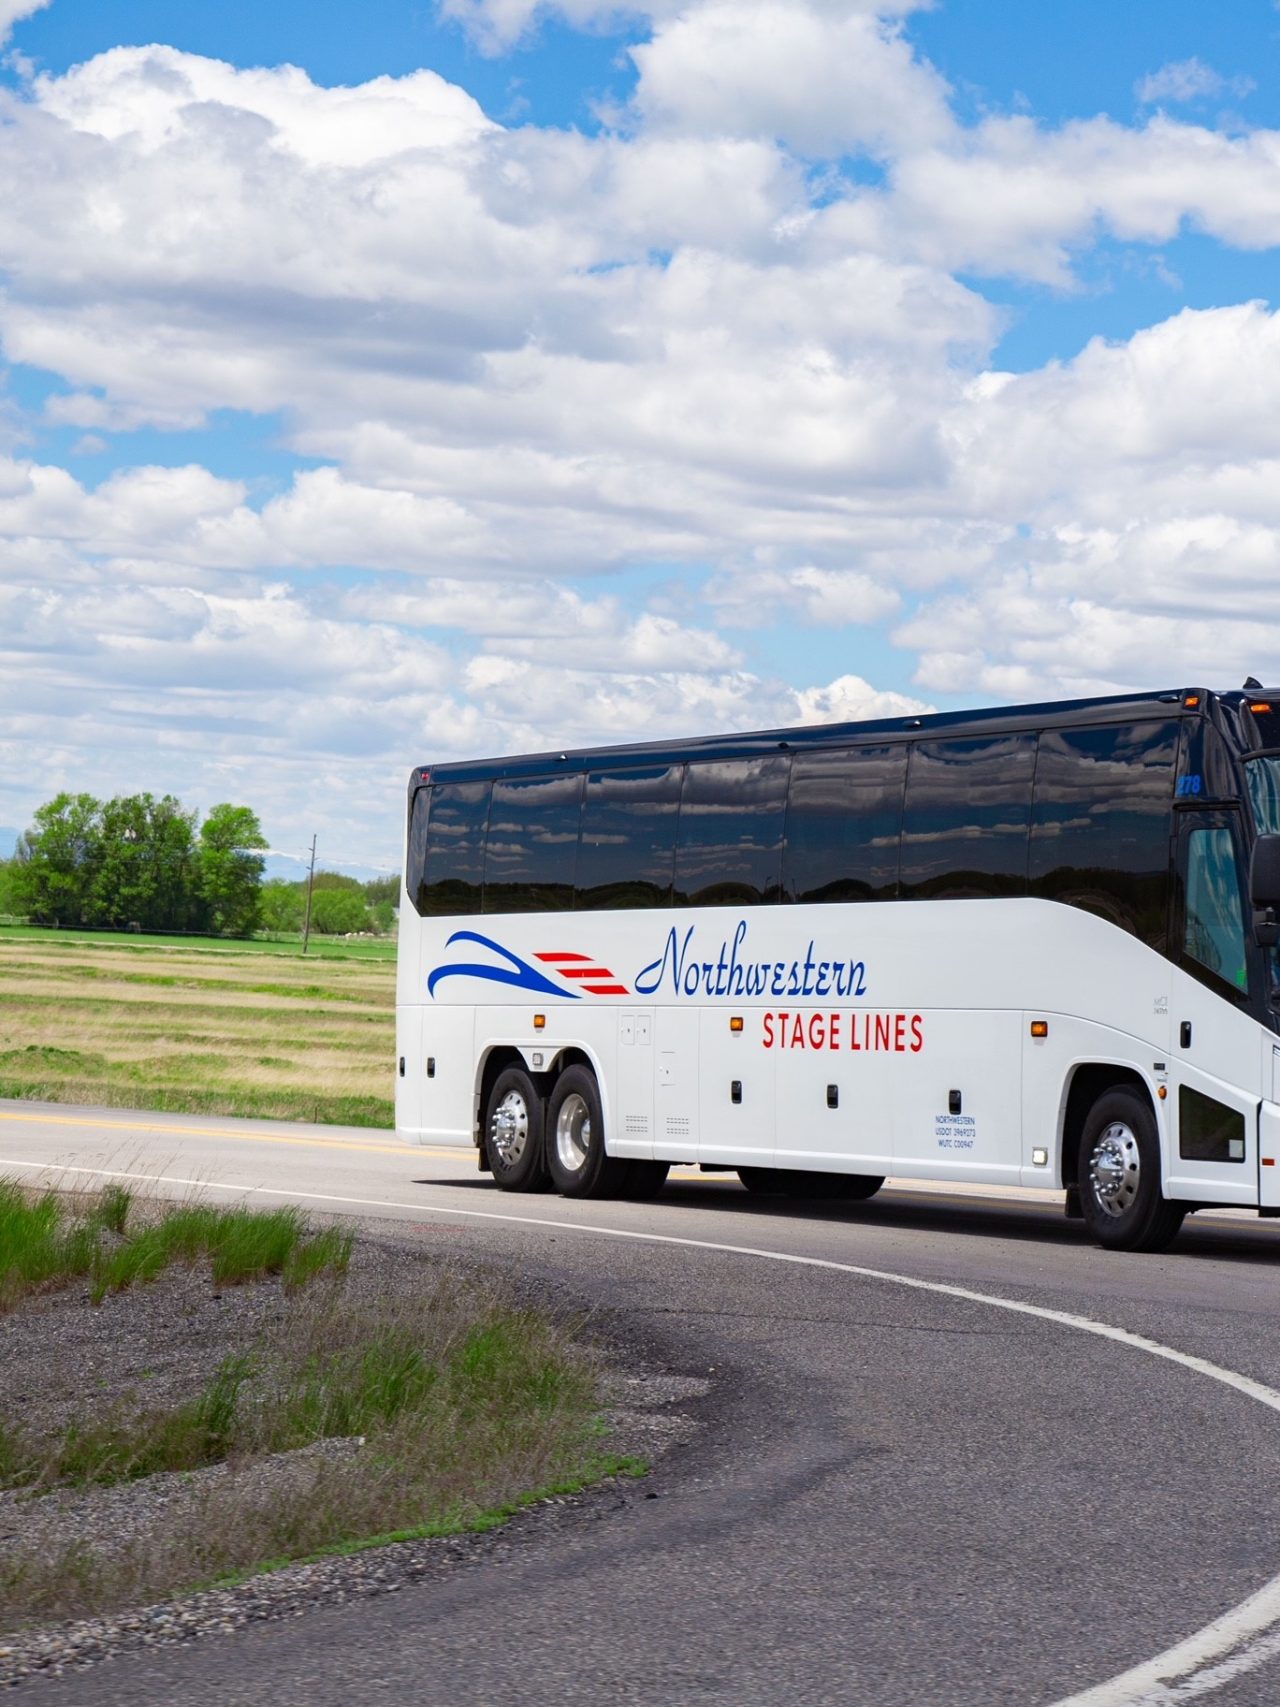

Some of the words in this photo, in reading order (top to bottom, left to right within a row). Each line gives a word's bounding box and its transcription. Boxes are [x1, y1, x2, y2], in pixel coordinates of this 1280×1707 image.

[1176, 774, 1201, 796] 278
[634, 920, 867, 996] Northwestern
[762, 1012, 840, 1050] STAGE
[850, 1013, 923, 1052] LINES
[935, 1115, 976, 1125] NORTHWESTERN
[935, 1127, 952, 1136] USDOT
